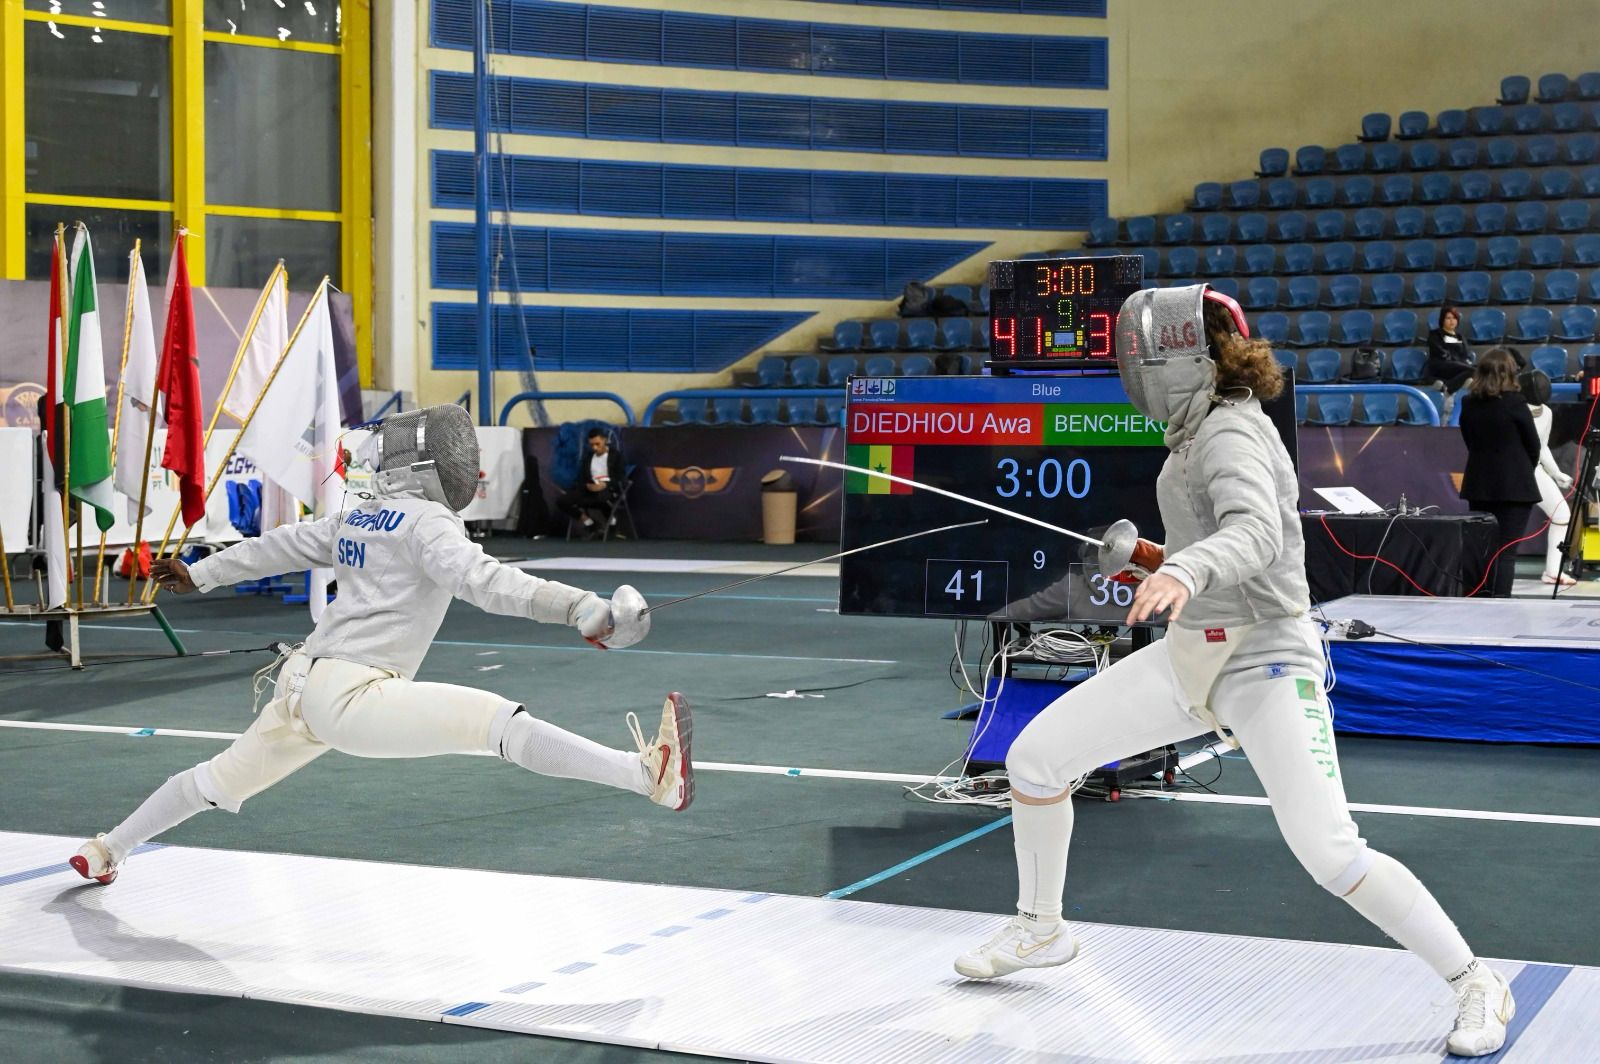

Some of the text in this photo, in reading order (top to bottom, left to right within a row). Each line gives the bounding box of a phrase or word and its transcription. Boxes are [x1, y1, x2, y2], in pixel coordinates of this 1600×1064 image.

[1036, 264, 1094, 296] 3:00
[1057, 299, 1073, 329] 9
[994, 317, 1041, 356] 41
[1160, 321, 1197, 349] ALG
[1032, 383, 1062, 396] Blue
[853, 412, 1031, 434] DIEDHIOU Awa
[225, 452, 257, 475] EGY
[995, 458, 1092, 499] 3:00
[338, 537, 366, 569] SEN
[1033, 550, 1046, 570] 9
[944, 569, 983, 601] 41
[1089, 573, 1133, 607] 36
